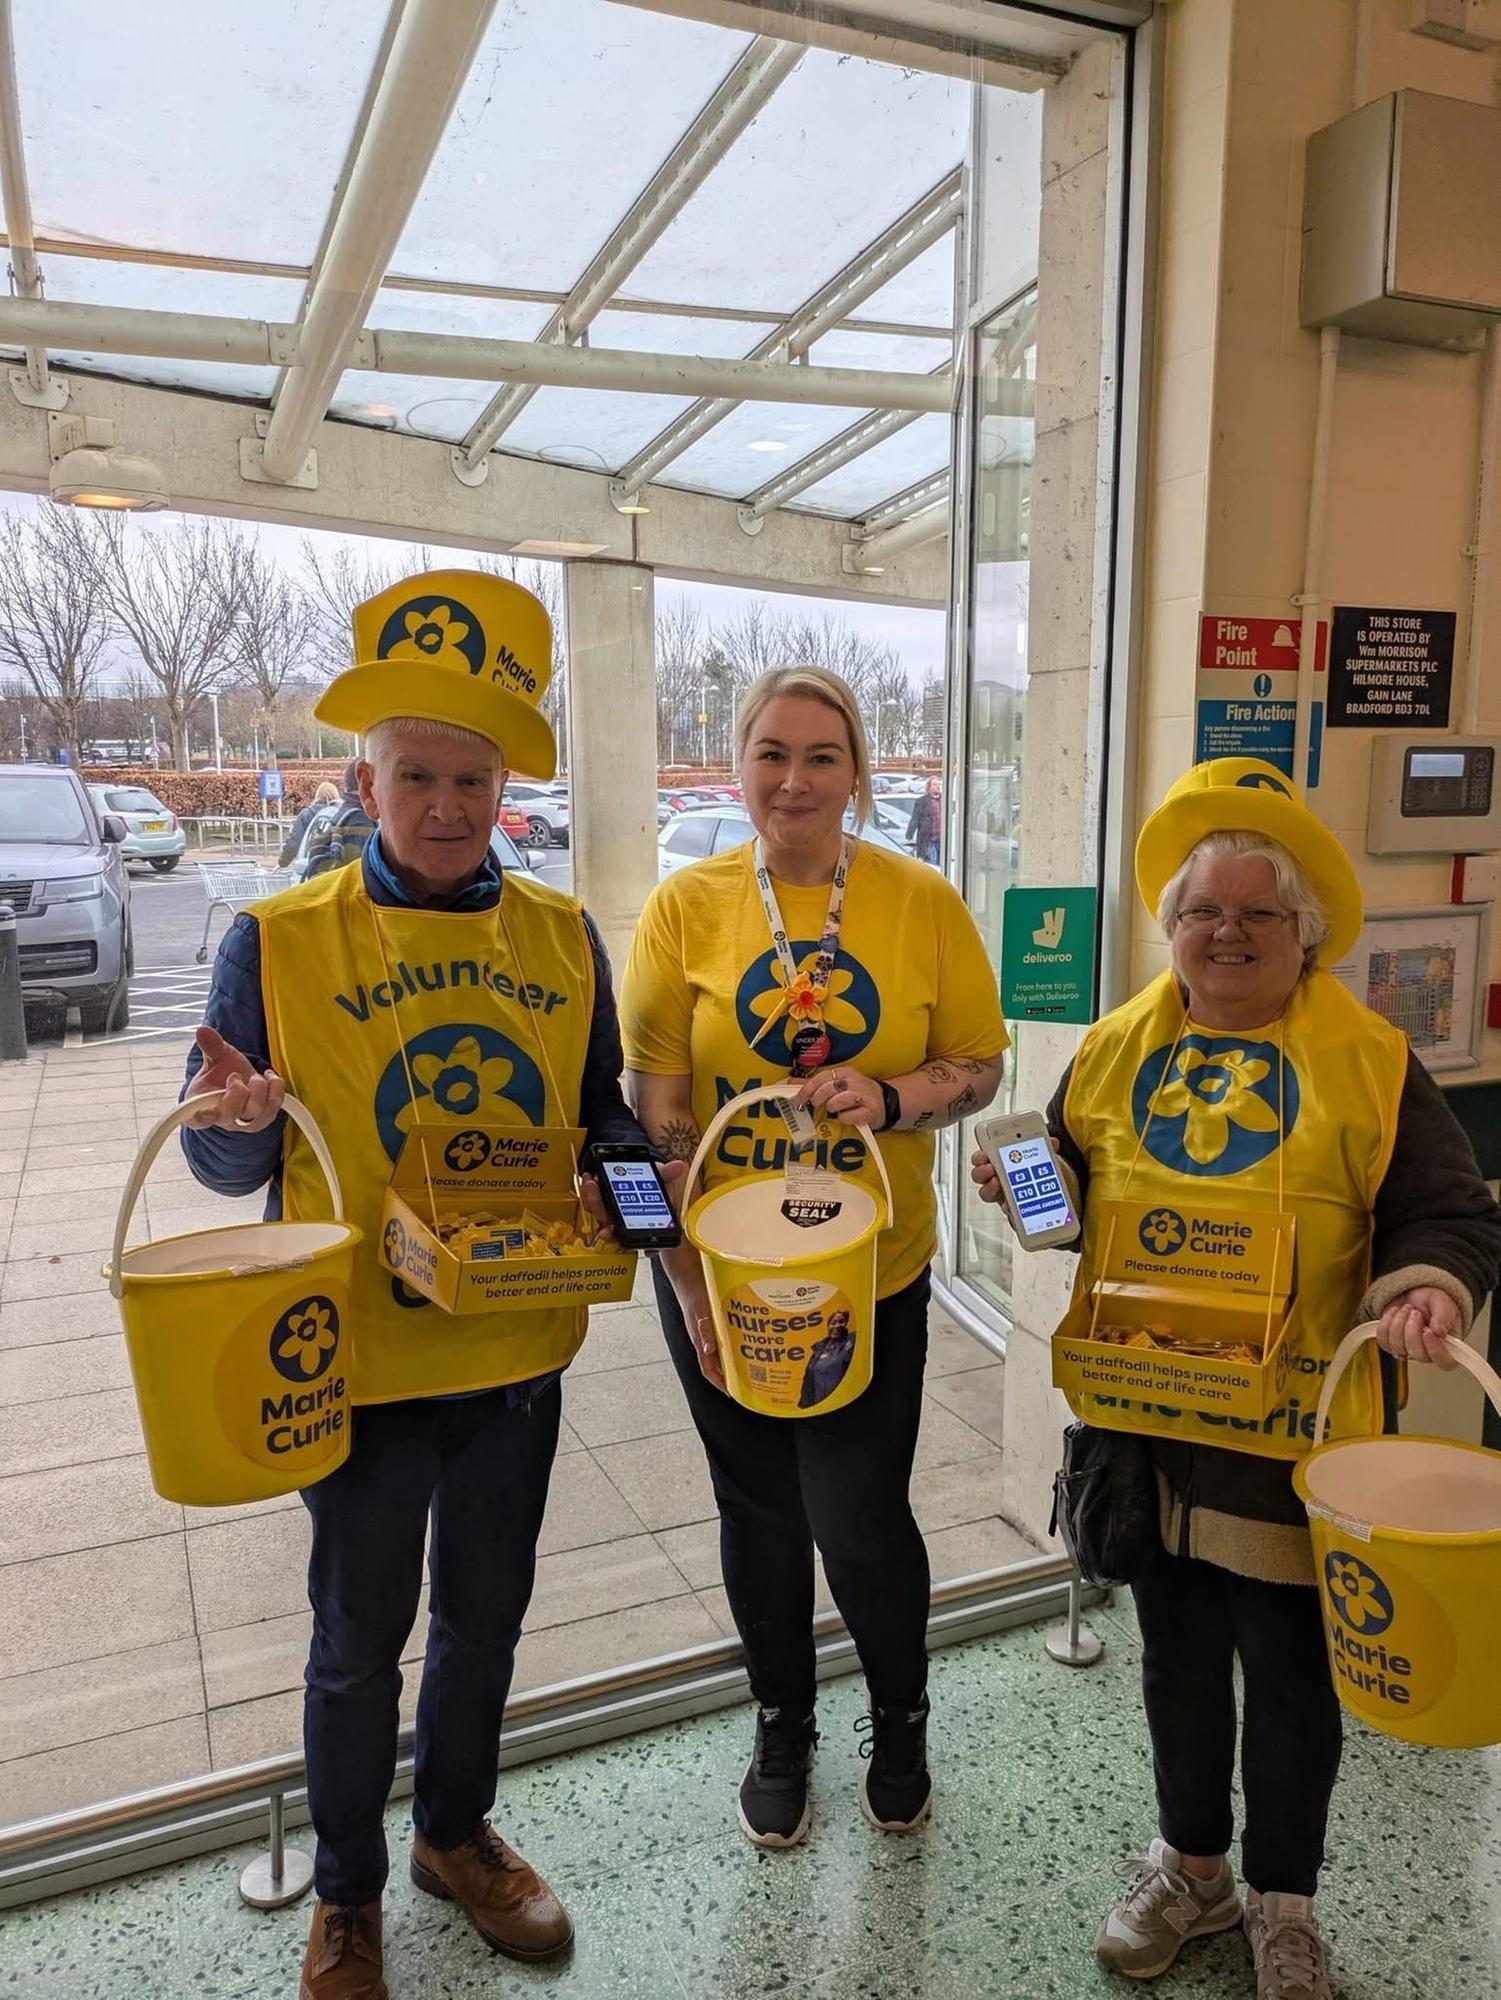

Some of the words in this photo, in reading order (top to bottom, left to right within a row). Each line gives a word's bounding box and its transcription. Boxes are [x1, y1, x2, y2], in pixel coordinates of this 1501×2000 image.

[1217, 620, 1248, 641] Fire
[1369, 616, 1390, 628] THIS
[1392, 617, 1422, 629] STORE
[1357, 630, 1366, 641] IS
[1369, 631, 1416, 643] OPERATED
[1419, 633, 1431, 644] BY
[1216, 646, 1257, 666] Point
[1359, 645, 1376, 656] Wm
[1377, 646, 1428, 658] MORRISON
[496, 645, 537, 693] Marie
[1345, 659, 1419, 672] SUPERMARKETS
[1421, 661, 1438, 673] PLC
[1353, 674, 1393, 685] HILMORE
[1396, 675, 1429, 687] HOUSE,
[1367, 690, 1389, 701] GAIN
[1391, 691, 1413, 701] LANE
[1226, 704, 1252, 720] Fire
[1254, 704, 1296, 721] Action
[1346, 703, 1392, 714] BRADFORD
[1395, 704, 1412, 715] BD3
[1415, 704, 1431, 715] 7DL
[1023, 952, 1072, 964] deliveroo
[334, 960, 568, 1022] Volunteer
[1016, 983, 1034, 991] From
[1036, 982, 1052, 991] here
[1063, 984, 1077, 992] you
[1012, 993, 1028, 1004] Only
[1029, 993, 1044, 1001] with
[1046, 992, 1079, 1001] Deliveroo
[495, 1137, 549, 1152] Marie
[717, 1126, 865, 1171] Curie
[490, 1153, 539, 1168] Curie
[423, 1176, 465, 1186] Please
[467, 1178, 510, 1188] donate
[512, 1179, 546, 1189] today
[1015, 1173, 1026, 1181] £3
[1018, 1188, 1033, 1199] £10
[1041, 1181, 1057, 1192] £20
[789, 1200, 836, 1208] SECURITY
[789, 1207, 830, 1219] SEAL
[1190, 1218, 1253, 1238] Marie
[408, 1237, 438, 1267] Marie
[1189, 1237, 1246, 1256] Curie
[406, 1256, 433, 1285] Curie
[470, 1273, 497, 1285] Your
[500, 1270, 549, 1284] daffodil
[551, 1267, 583, 1282] helps
[584, 1265, 628, 1279] provide
[1124, 1259, 1168, 1273] Please
[1169, 1265, 1218, 1279] donate
[1220, 1270, 1260, 1283] today
[485, 1287, 523, 1298] better
[526, 1284, 549, 1295] end
[551, 1283, 565, 1293] of
[566, 1281, 584, 1293] life
[586, 1281, 612, 1291] care
[730, 1298, 769, 1315] More
[727, 1310, 823, 1333] nurses
[742, 1333, 785, 1345] more
[740, 1344, 805, 1362] care
[1062, 1350, 1093, 1364] Your
[1095, 1355, 1150, 1373] daffodil
[1153, 1363, 1191, 1380] helps
[1193, 1371, 1250, 1388] provide
[1082, 1368, 1124, 1383] better
[1127, 1374, 1153, 1388] end
[1155, 1378, 1171, 1390] of
[1173, 1381, 1196, 1396] life
[1199, 1388, 1232, 1401] care
[260, 1376, 345, 1425] Marie
[266, 1409, 344, 1454] Curie
[1331, 1624, 1411, 1676] Marie
[1334, 1648, 1410, 1704] Curie
